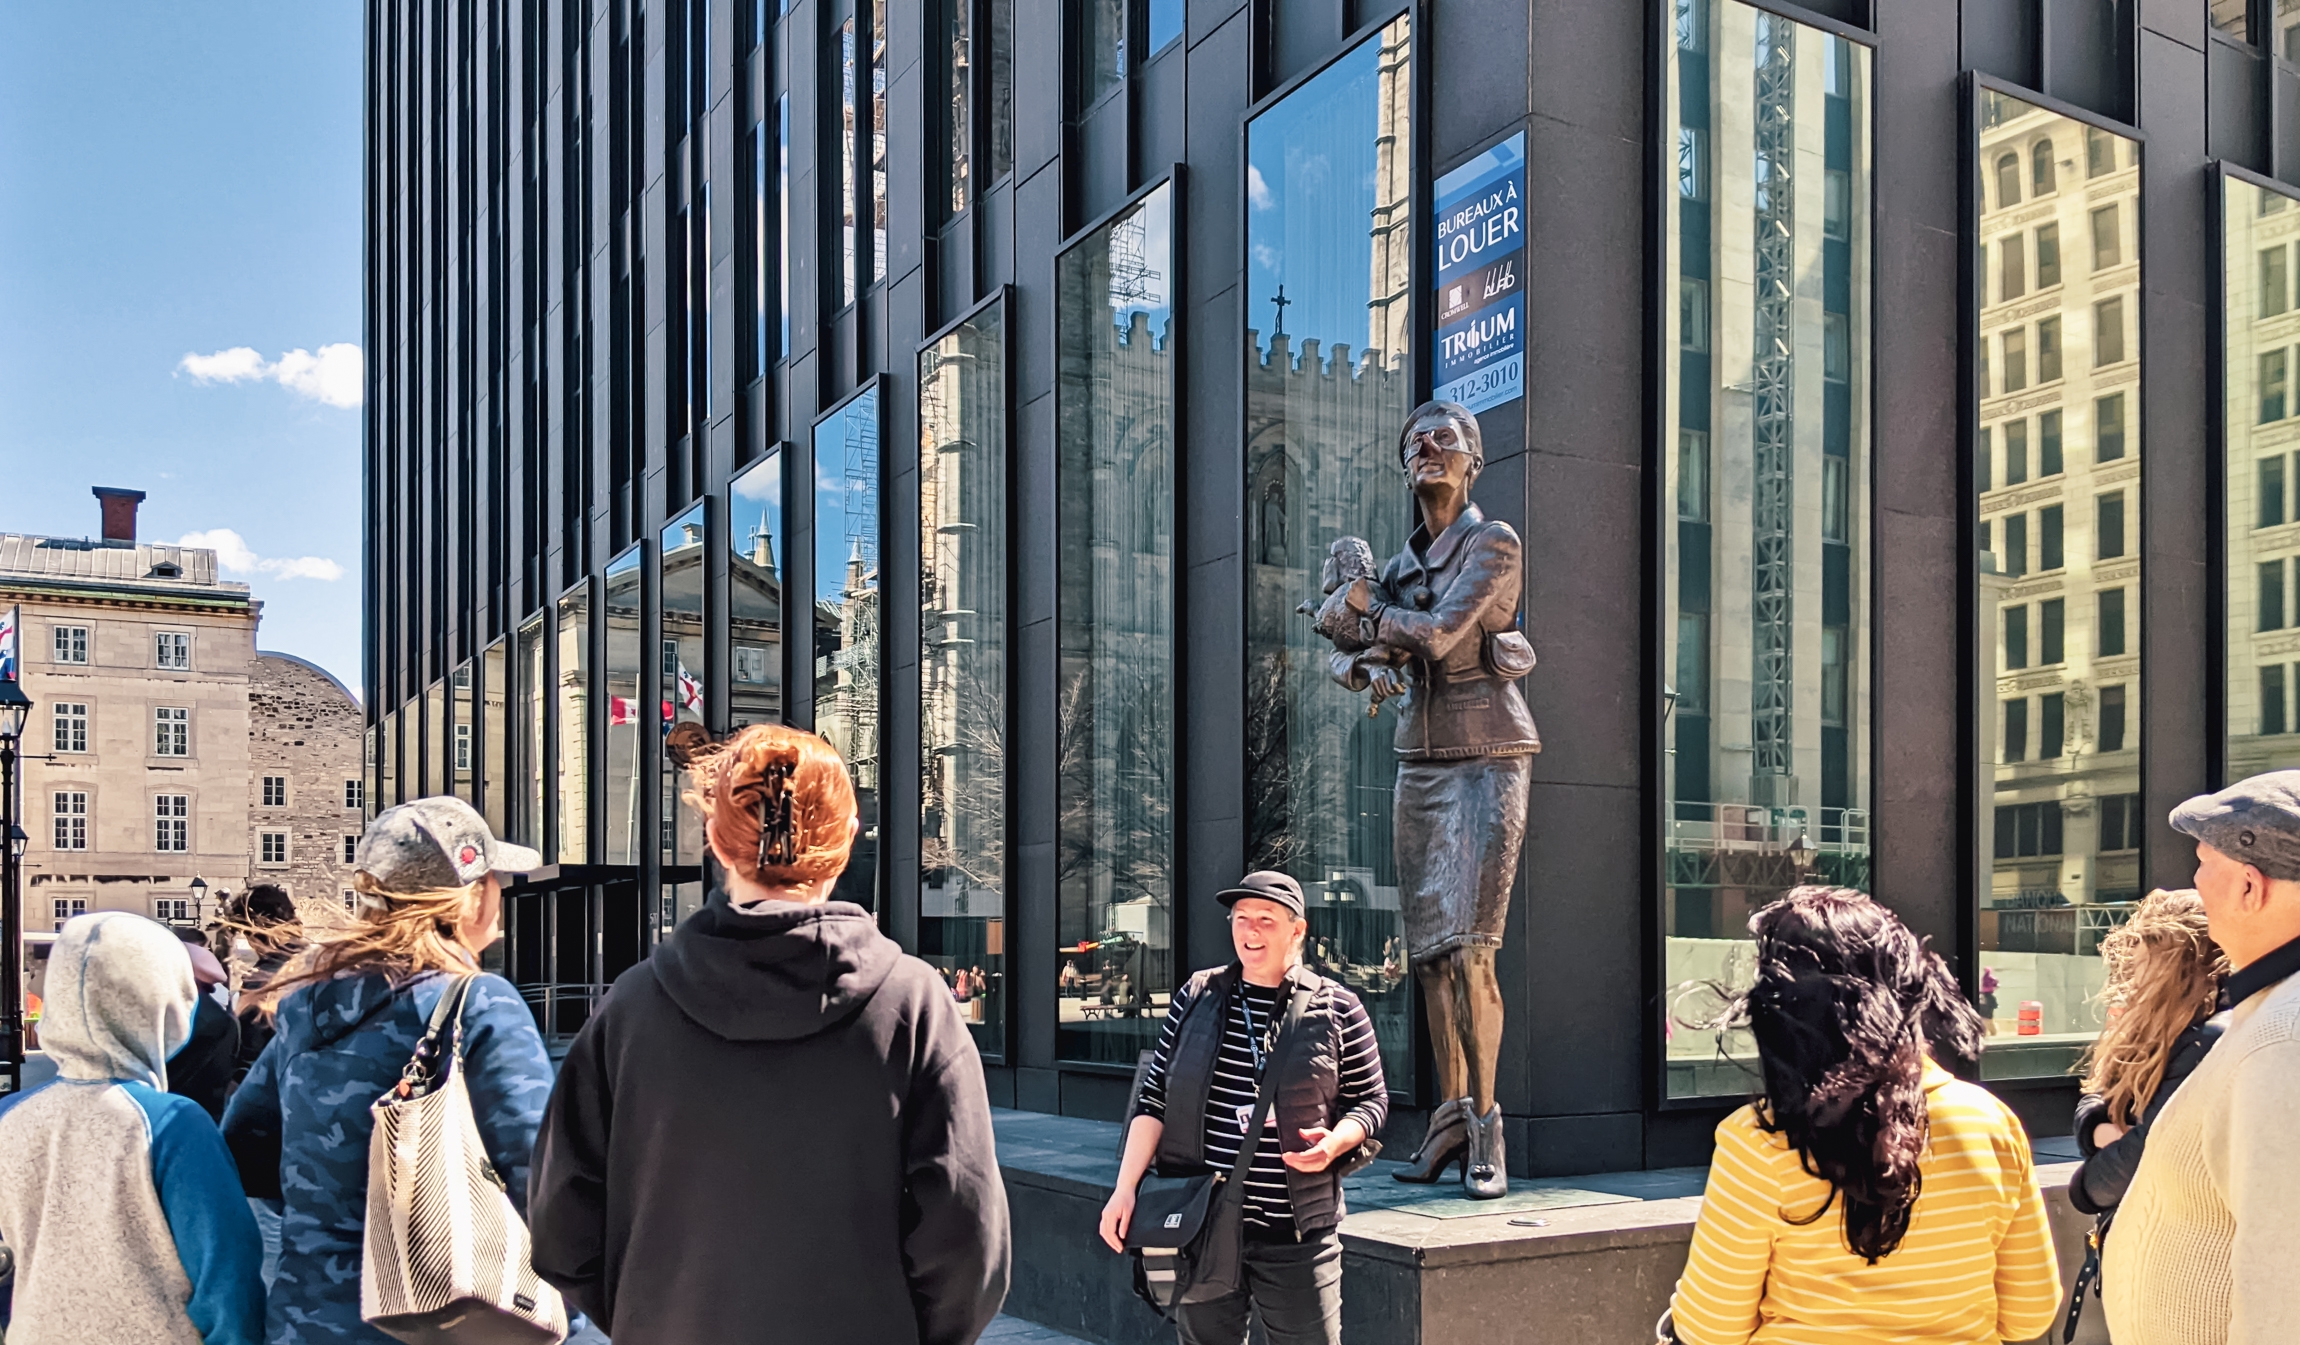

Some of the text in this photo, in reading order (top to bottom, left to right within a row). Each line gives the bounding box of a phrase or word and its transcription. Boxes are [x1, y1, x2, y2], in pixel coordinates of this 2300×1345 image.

[1438, 180, 1518, 240] BUREAUX À
[1438, 206, 1519, 272] LOUER
[1445, 333, 1515, 369] IMMOBILIER
